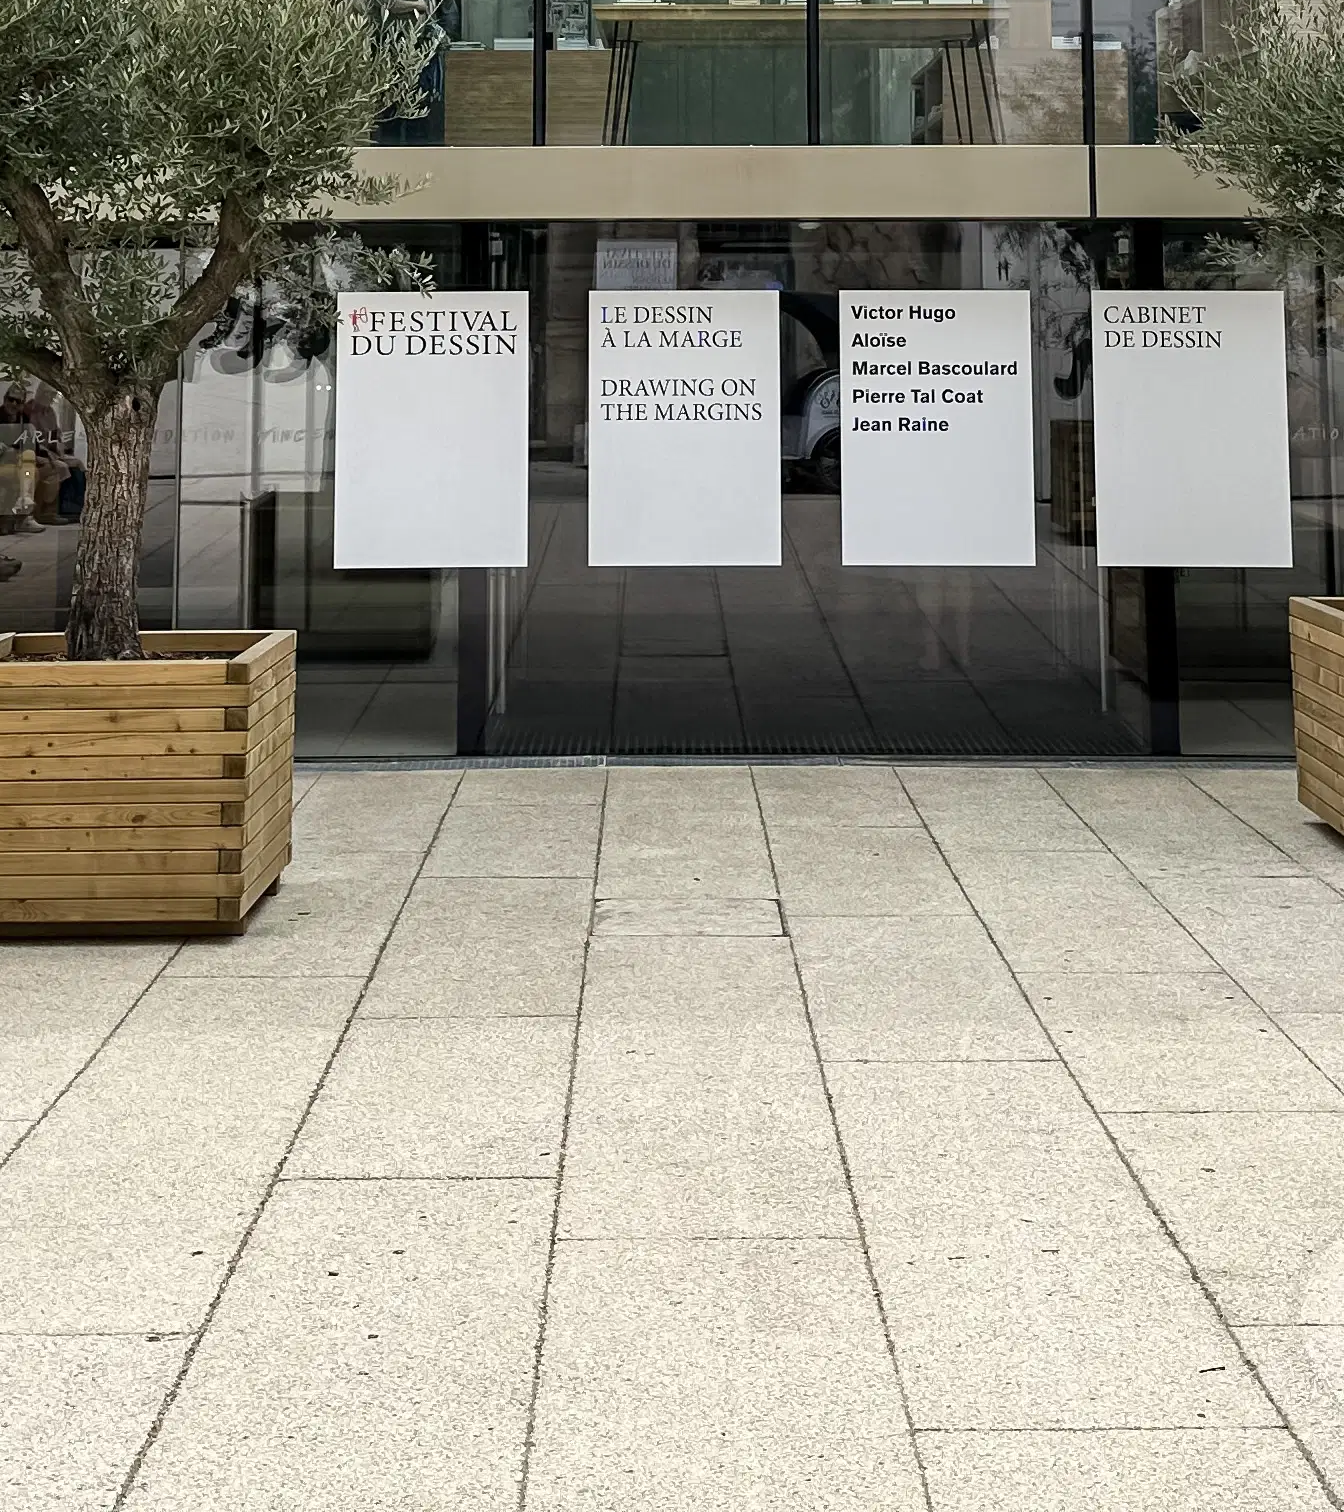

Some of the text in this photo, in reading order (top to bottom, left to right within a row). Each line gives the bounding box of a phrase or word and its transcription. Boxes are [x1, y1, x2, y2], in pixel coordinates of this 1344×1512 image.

[369, 310, 518, 332] FESTIVAL
[600, 306, 714, 324] LE DESSIN
[850, 305, 956, 323] Victor Hugo
[1104, 306, 1207, 324] CABINET
[350, 334, 518, 356] DU DESSIN
[600, 327, 743, 348] À LA MARGE
[851, 332, 907, 348] Aloïse
[1104, 330, 1223, 349] DE DESSIN
[852, 360, 1018, 376] Marcel Bascoulard
[600, 378, 757, 397] DRAWING ON
[852, 388, 984, 404] Pierre Tal Coat
[600, 402, 763, 421] THE MARGINS
[852, 416, 950, 432] Jean Raine
